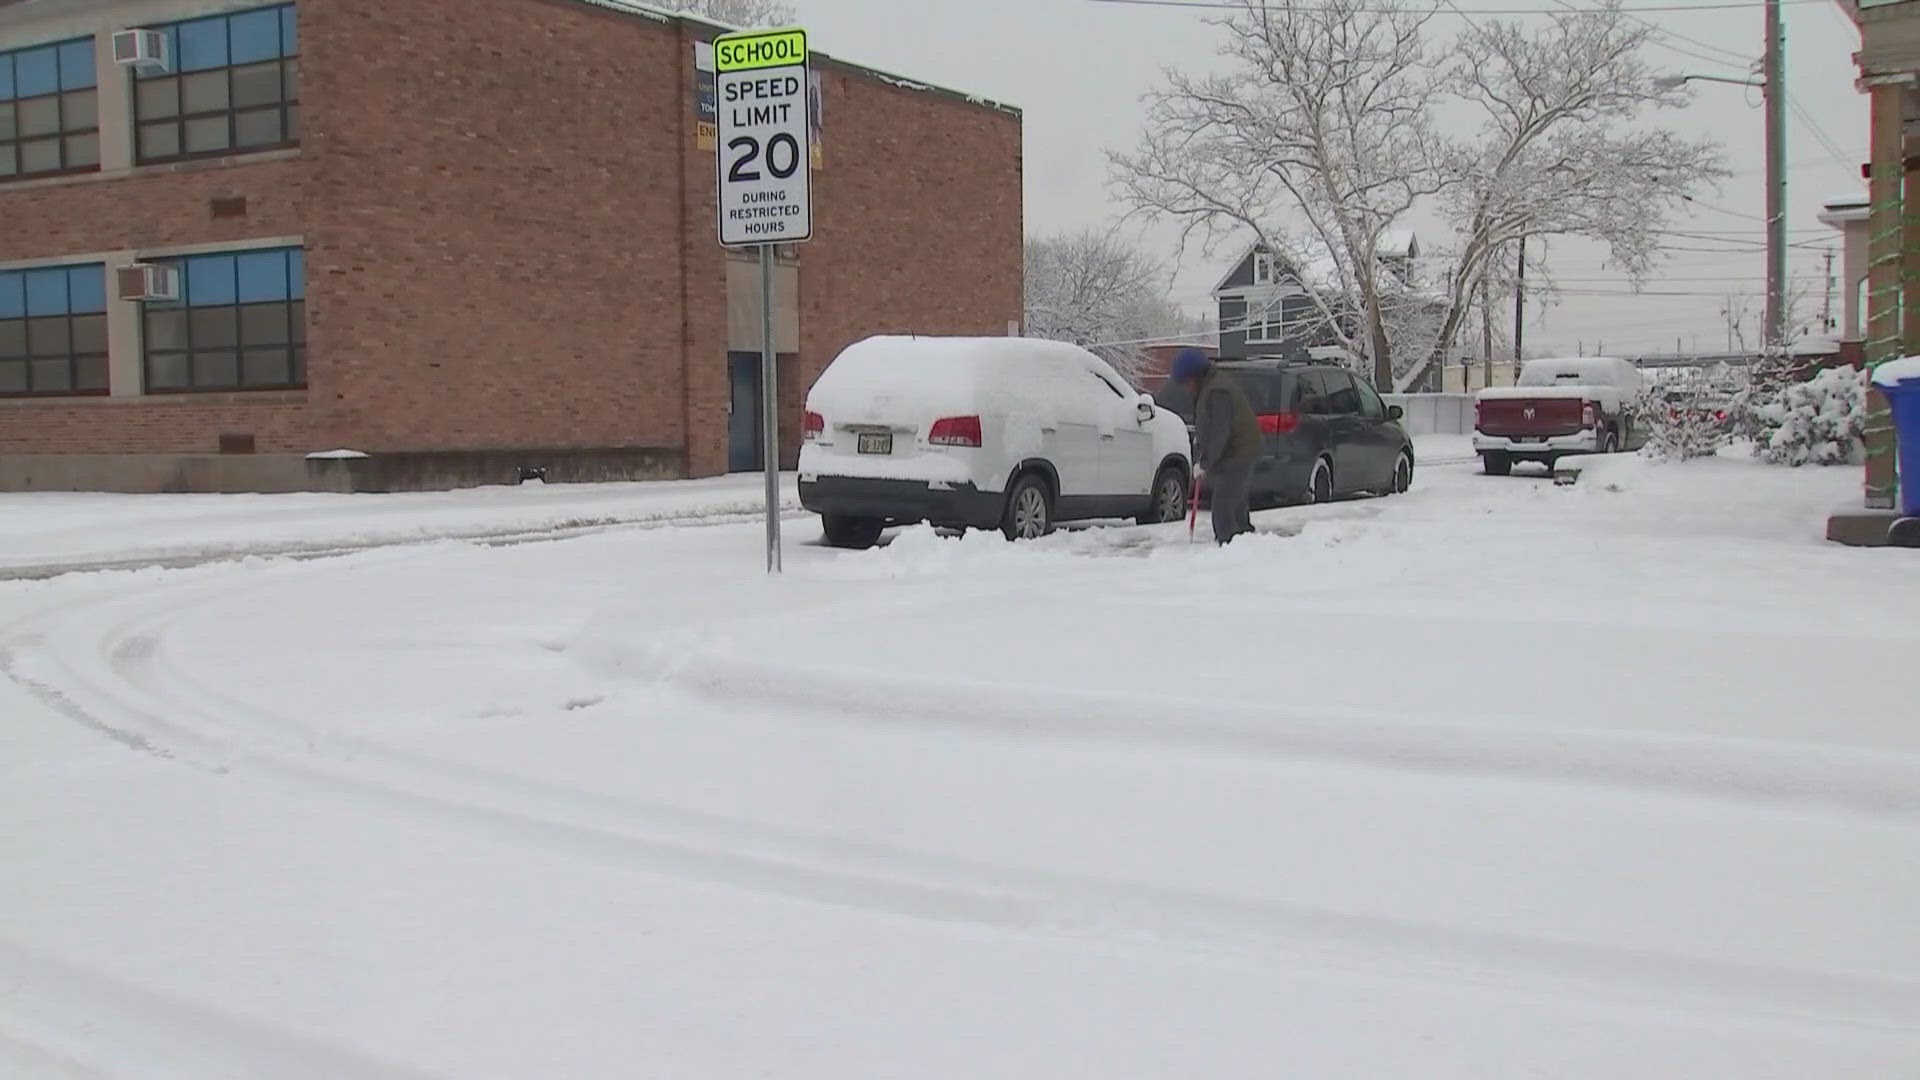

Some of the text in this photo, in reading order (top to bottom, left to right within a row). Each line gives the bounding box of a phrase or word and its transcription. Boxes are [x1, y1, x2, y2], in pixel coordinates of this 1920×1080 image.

[721, 38, 801, 65] SCHOOL
[725, 77, 799, 102] SPEED
[733, 103, 791, 128] LIMIT
[727, 132, 800, 183] 20
[742, 190, 786, 204] DURING
[729, 204, 800, 220] RESTRICTED
[745, 221, 785, 234] HOURS
